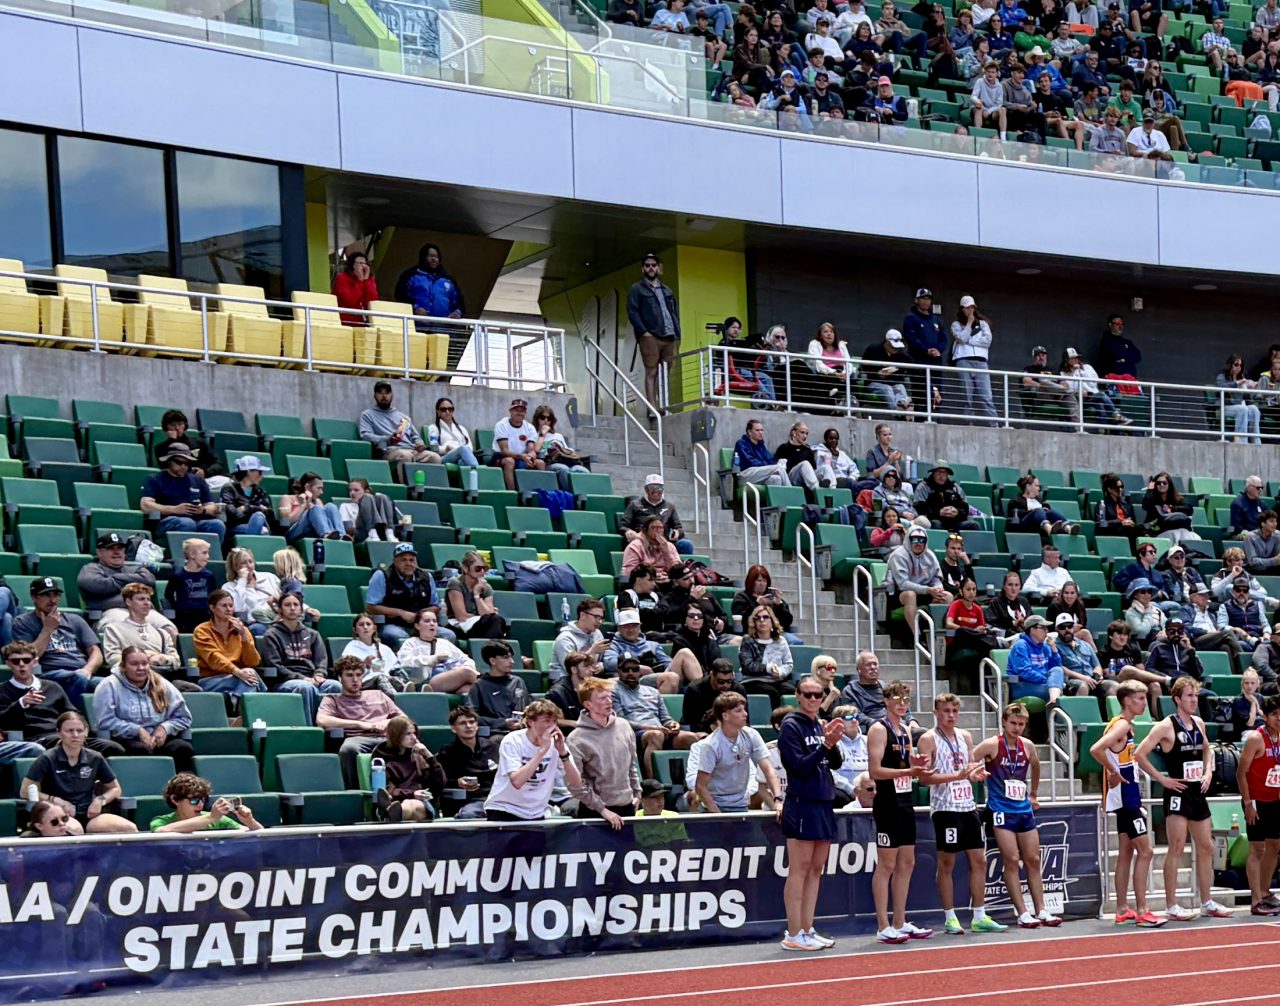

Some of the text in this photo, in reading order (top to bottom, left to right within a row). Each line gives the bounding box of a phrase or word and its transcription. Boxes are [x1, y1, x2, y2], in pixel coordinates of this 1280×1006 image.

[1172, 797, 1179, 810] 5
[995, 812, 1003, 825] 6
[1136, 820, 1144, 832] 2
[878, 833, 888, 846] 10
[949, 829, 955, 842] 3
[107, 867, 337, 917] ONPOINT
[344, 849, 620, 903] COMMUNITY
[623, 846, 768, 884] CREDIT
[123, 889, 748, 973] STATE CHAMPIONSHIPS
